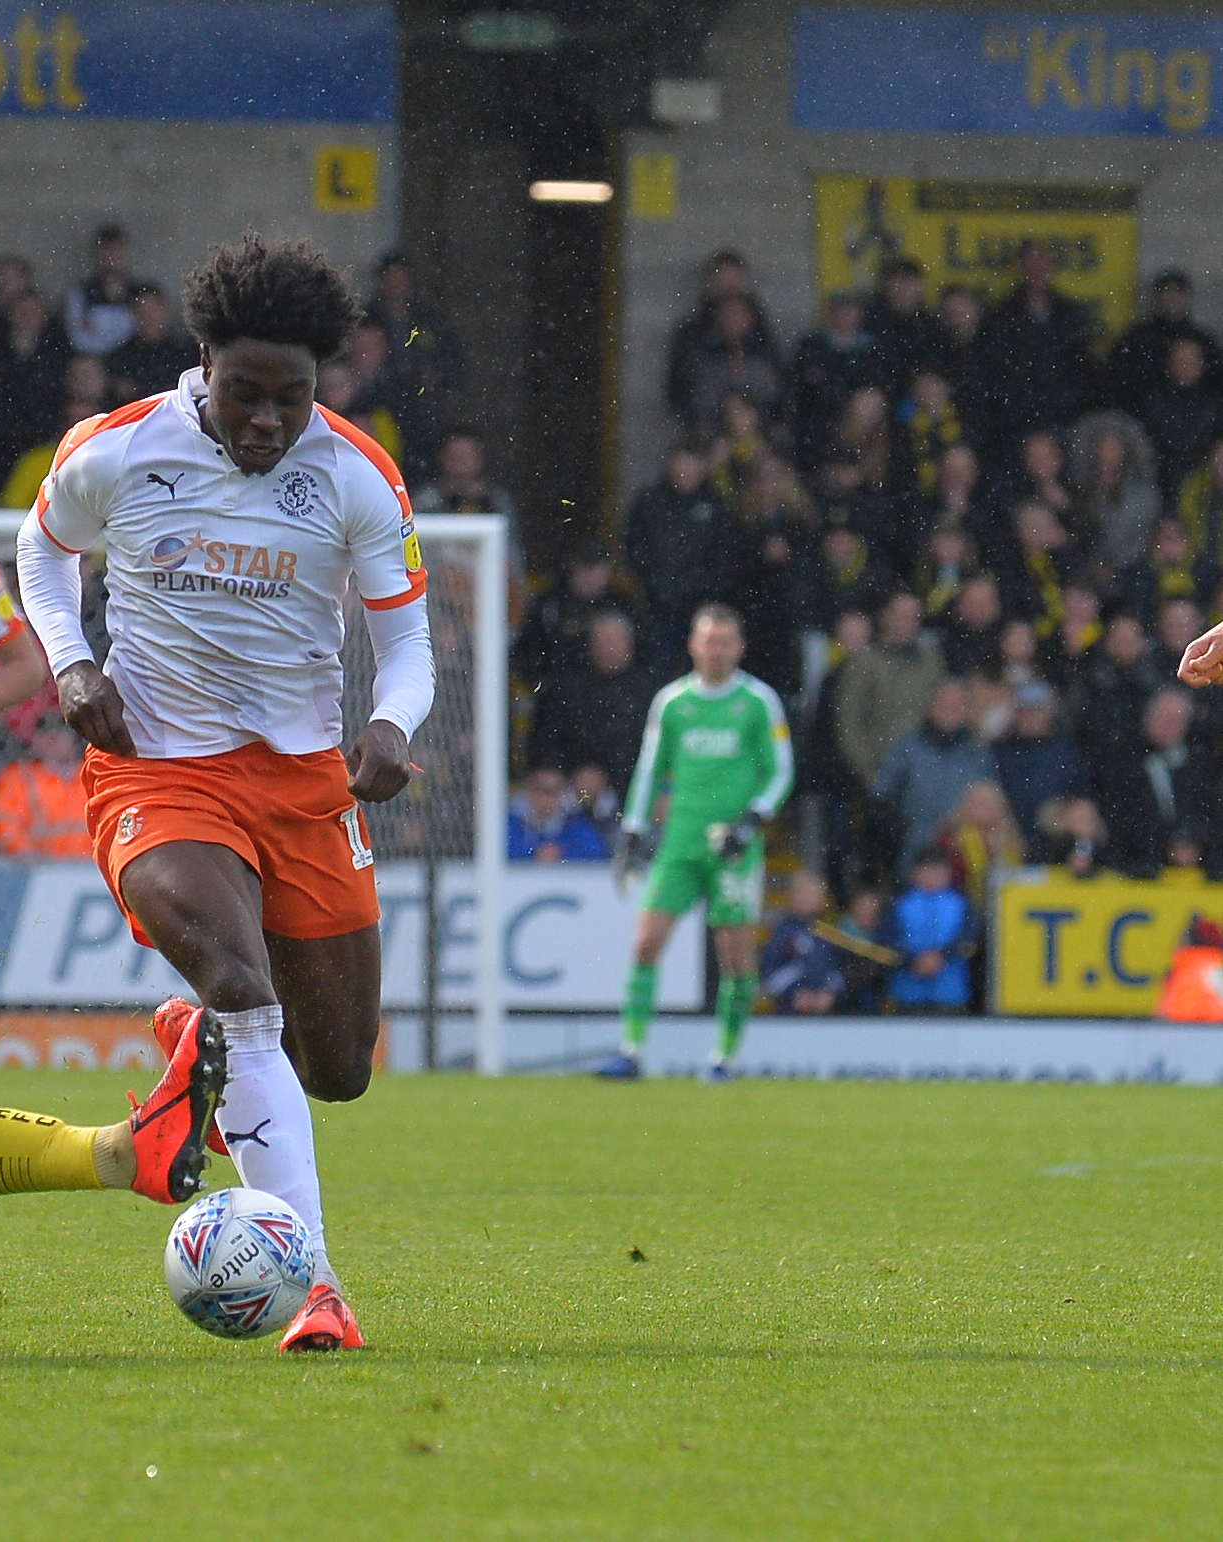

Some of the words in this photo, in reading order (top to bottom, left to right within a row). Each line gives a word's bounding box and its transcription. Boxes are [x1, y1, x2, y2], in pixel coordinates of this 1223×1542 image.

[944, 222, 1104, 273] Luas
[204, 541, 298, 580] STAR
[153, 572, 291, 598] PLATFORMS
[56, 886, 584, 986] PTEC
[209, 1241, 260, 1289] mitre
